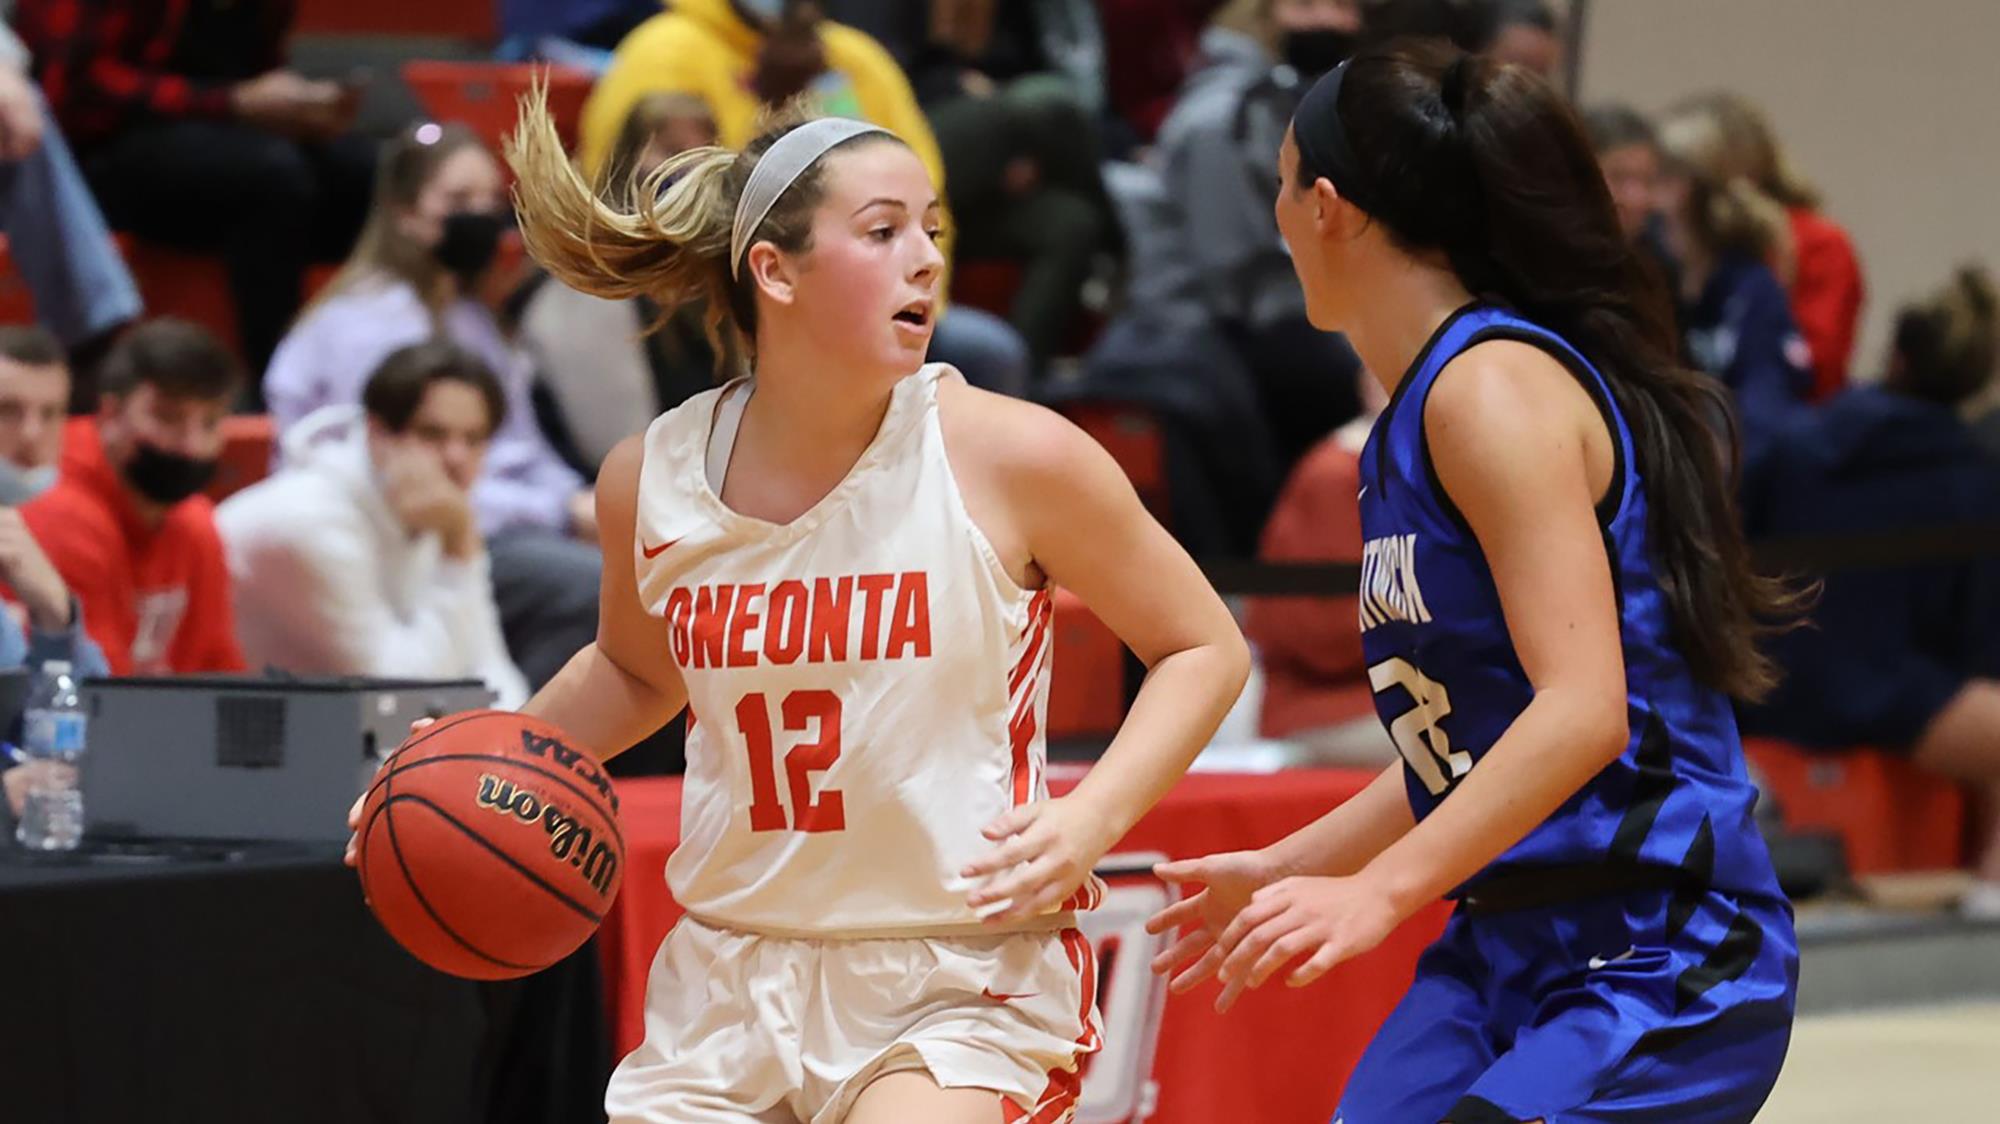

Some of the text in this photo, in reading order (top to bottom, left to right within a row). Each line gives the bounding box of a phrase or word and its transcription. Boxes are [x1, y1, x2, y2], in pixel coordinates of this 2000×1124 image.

[664, 571, 932, 669] ONEONTA
[735, 689, 846, 833] 12
[476, 773, 618, 896] Wilson
